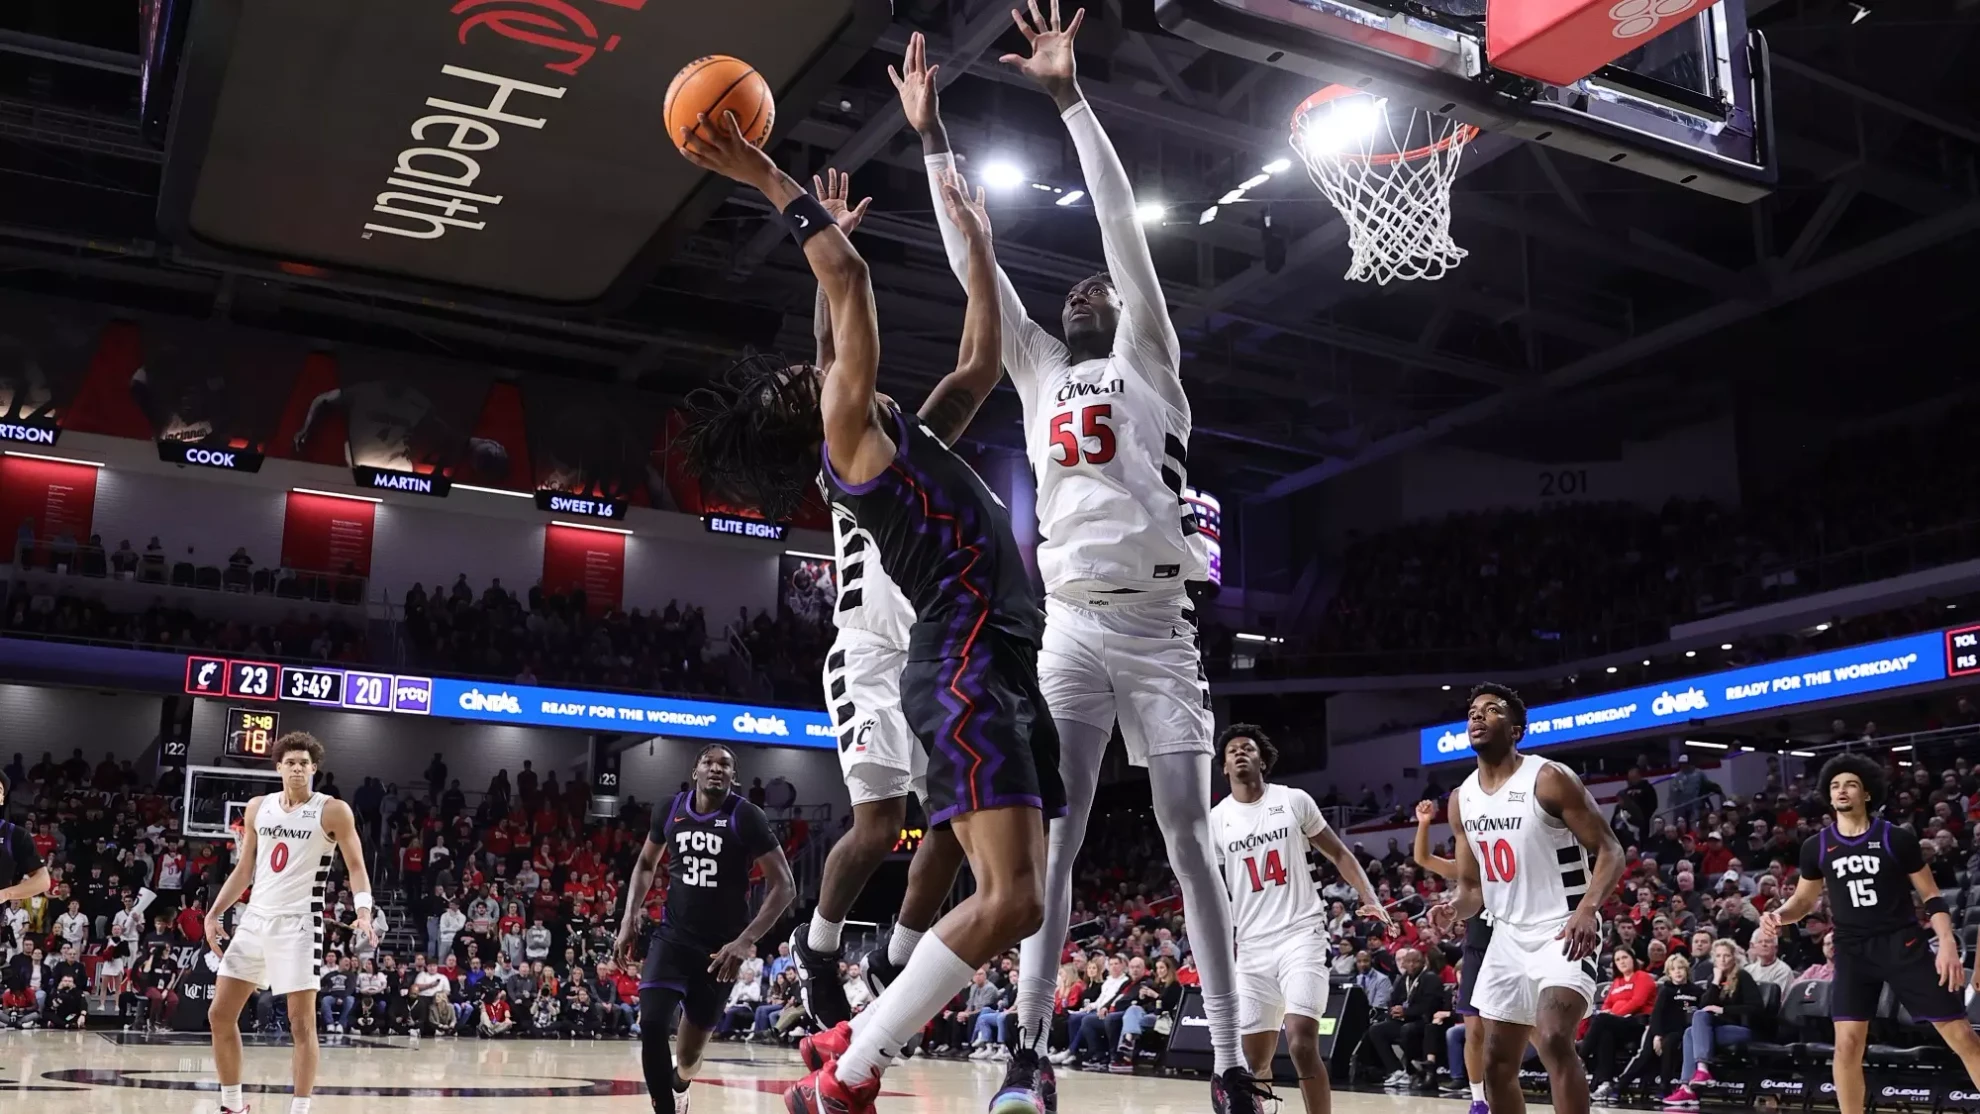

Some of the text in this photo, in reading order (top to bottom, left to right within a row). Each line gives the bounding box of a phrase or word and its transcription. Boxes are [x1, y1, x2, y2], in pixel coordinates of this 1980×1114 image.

[364, 64, 567, 240] Health
[1049, 403, 1117, 467] 55
[186, 448, 235, 467] COOK
[374, 472, 431, 492] MARTIN
[1538, 469, 1588, 497] 201
[550, 496, 613, 517] SWEET 16
[711, 518, 783, 540] ELITE EIGHT
[1954, 633, 1978, 648] TOL
[1957, 654, 1977, 669] FLS
[239, 665, 268, 695] 23
[291, 672, 332, 699] 3:49
[355, 677, 383, 705] 20
[1725, 681, 1770, 700] READY
[1772, 675, 1801, 692] FOR
[1803, 670, 1831, 687] THE
[397, 686, 429, 703] TCU
[242, 713, 273, 731] 3:48
[541, 701, 586, 716] READY
[588, 705, 615, 719] FOR
[618, 708, 643, 721] THE
[806, 724, 839, 737] READ
[1529, 721, 1551, 735] FOR
[1552, 716, 1573, 731] THE
[164, 742, 186, 756] 122
[245, 729, 267, 754] 18
[259, 824, 312, 840] CINCINNATI
[1465, 814, 1522, 832] CINCINNATI
[675, 830, 723, 856] TCU
[1228, 826, 1289, 853] CINCINNATI
[270, 841, 289, 873] 0
[1477, 838, 1516, 883] 10
[1832, 854, 1880, 879] TCU
[682, 855, 718, 887] 32
[1243, 848, 1287, 893] 14
[1846, 878, 1878, 908] 15
